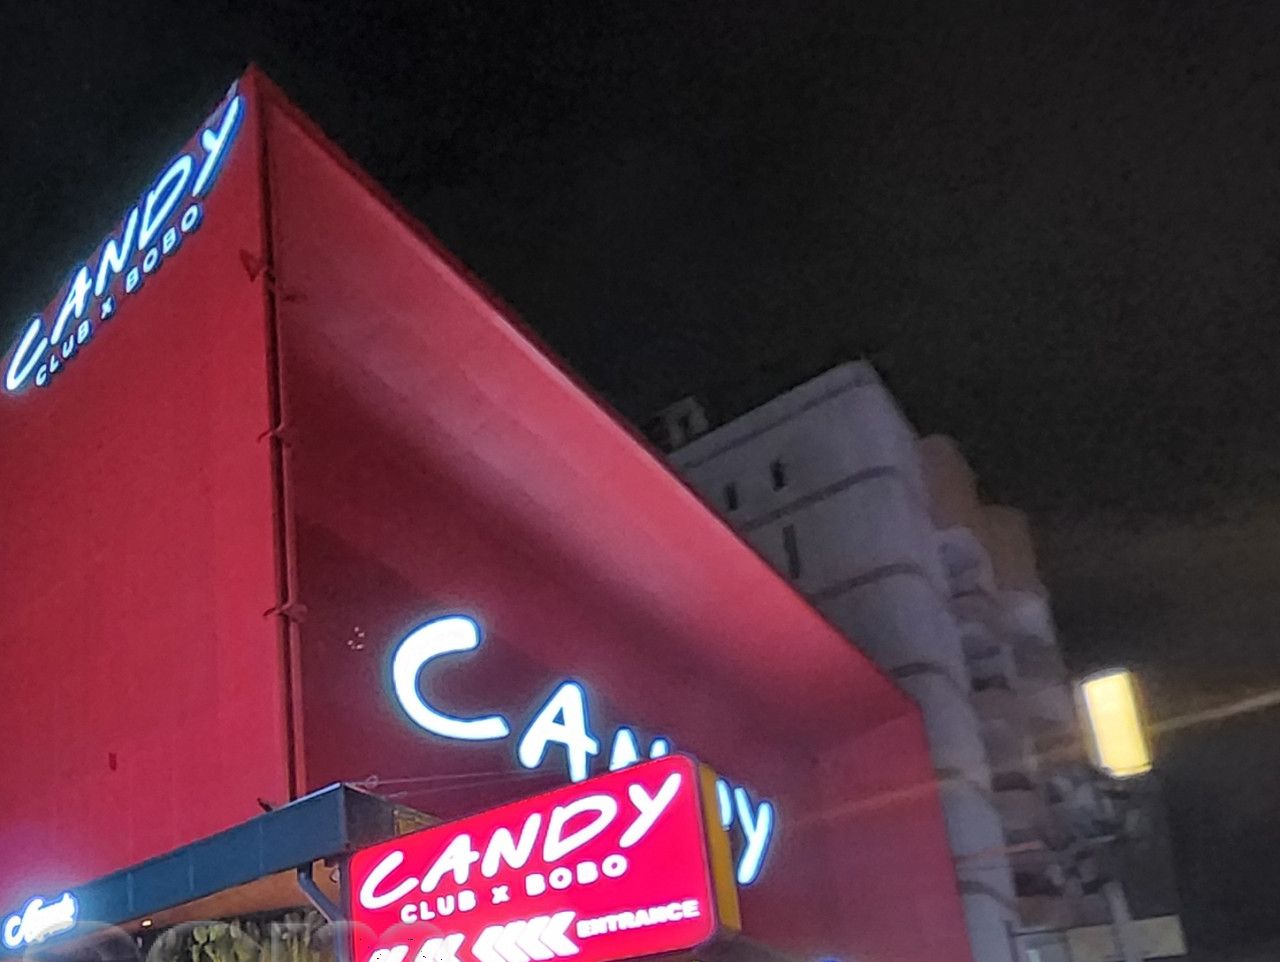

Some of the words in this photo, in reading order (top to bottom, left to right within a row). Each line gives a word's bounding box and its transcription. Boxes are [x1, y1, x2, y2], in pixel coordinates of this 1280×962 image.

[4, 95, 242, 392] CANDY
[34, 318, 91, 387] CLUB
[124, 203, 200, 294] BOBO
[392, 615, 772, 886] CAY
[358, 771, 683, 910] CANDY
[399, 889, 478, 925] CLUB
[524, 853, 629, 897] BOBO
[575, 898, 701, 939] ENTRANCE
